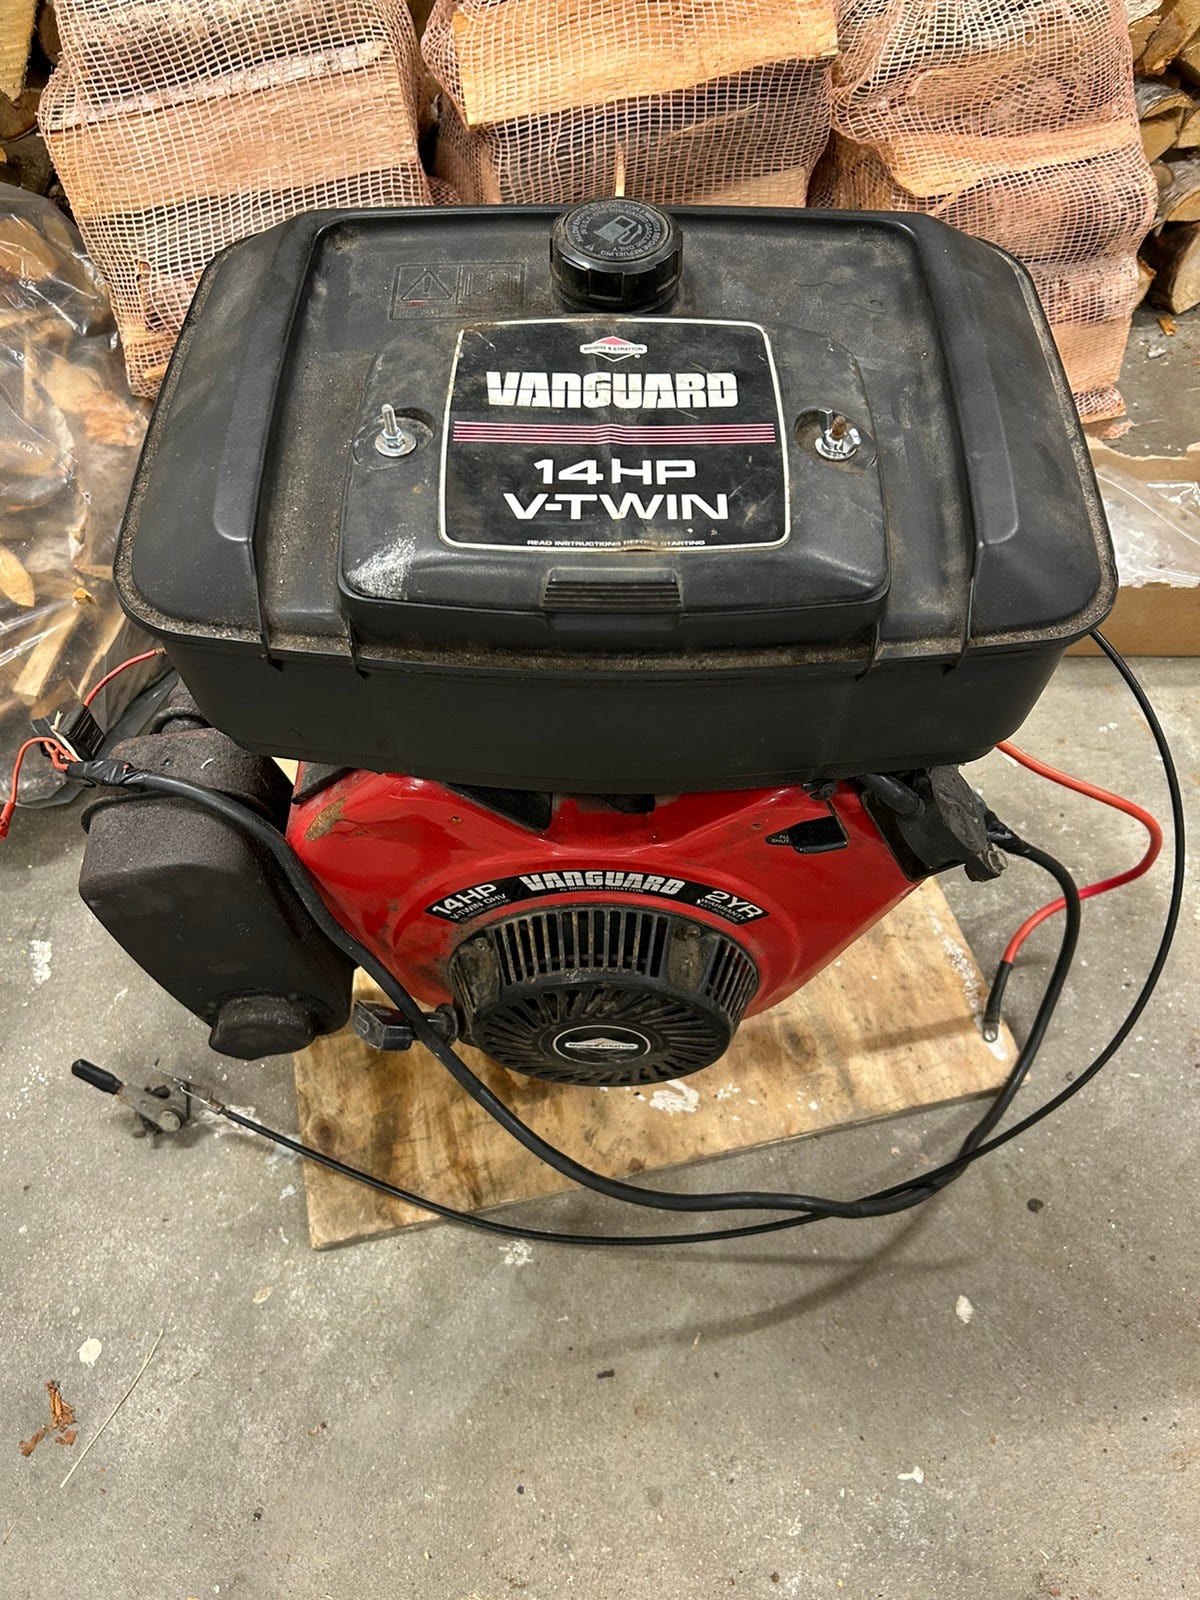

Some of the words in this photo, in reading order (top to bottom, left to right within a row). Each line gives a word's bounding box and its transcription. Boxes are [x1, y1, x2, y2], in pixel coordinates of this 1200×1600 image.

[486, 371, 739, 409] VANGUARD
[502, 492, 730, 521] V-TWIN
[519, 871, 686, 895] VANGUARD
[449, 901, 484, 919] V-TWIN
[704, 890, 764, 918] 2YR
